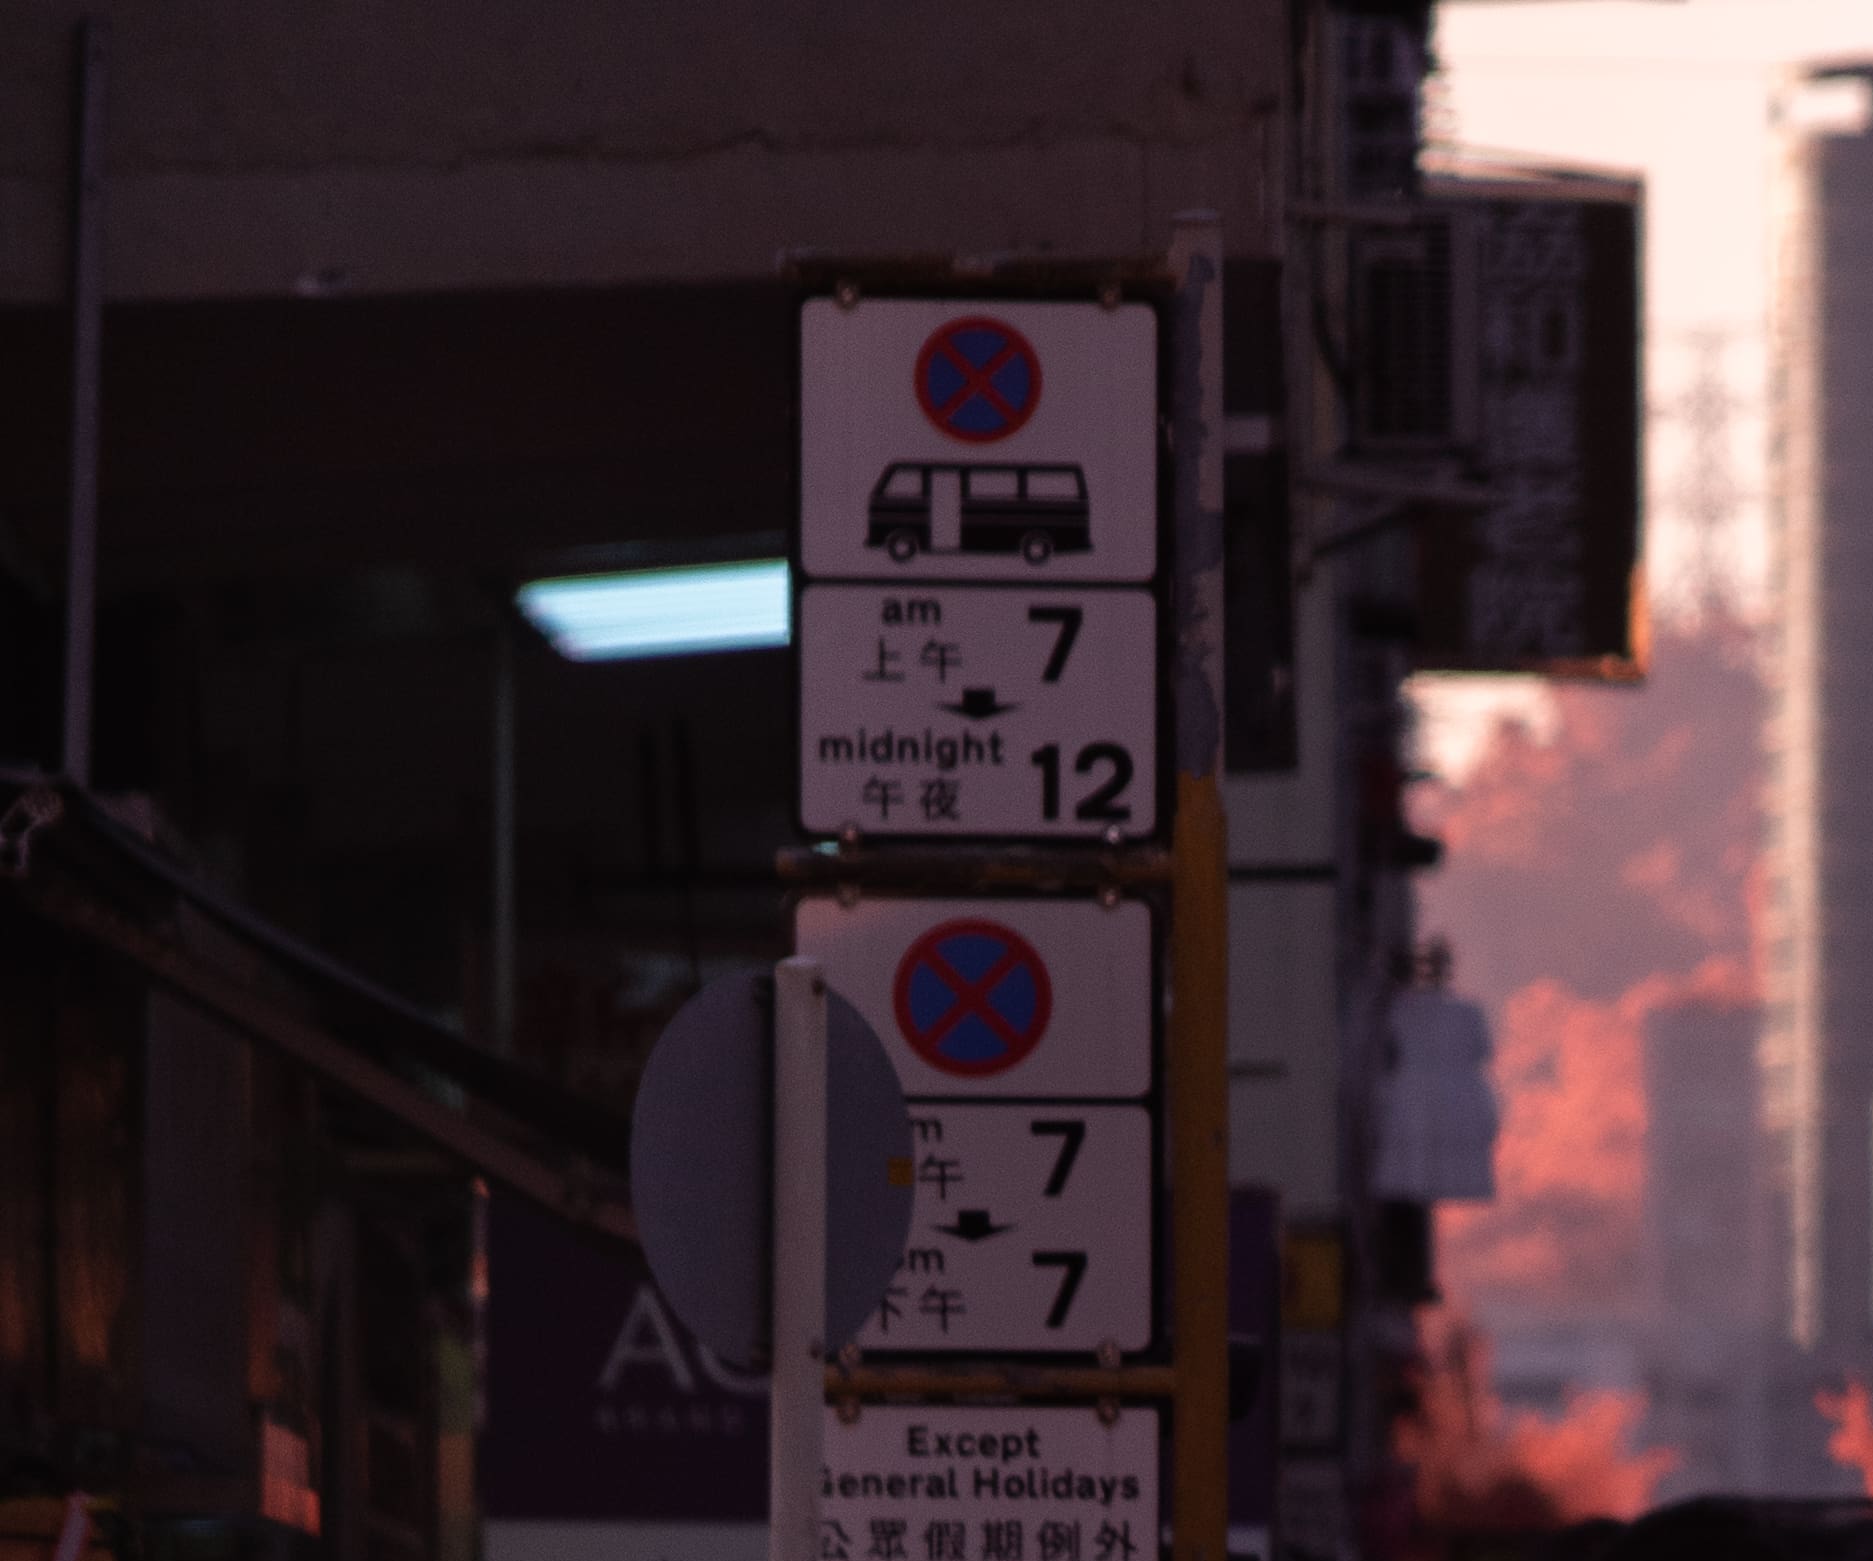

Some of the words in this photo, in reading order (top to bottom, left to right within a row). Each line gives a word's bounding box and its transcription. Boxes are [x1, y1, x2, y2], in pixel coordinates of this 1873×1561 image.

[881, 599, 942, 626] am
[861, 638, 962, 683] 上午
[1028, 607, 1083, 683] 7
[818, 728, 1003, 770] midnight
[862, 774, 960, 821] 午夜
[1031, 743, 1134, 821] 12
[908, 1117, 944, 1142] m
[918, 1154, 964, 1199] 午
[1030, 1121, 1086, 1196] 7
[900, 1249, 945, 1273] m
[1033, 1252, 1087, 1328] 7
[907, 1425, 1041, 1461] Except
[974, 1466, 1139, 1506] Holidays
